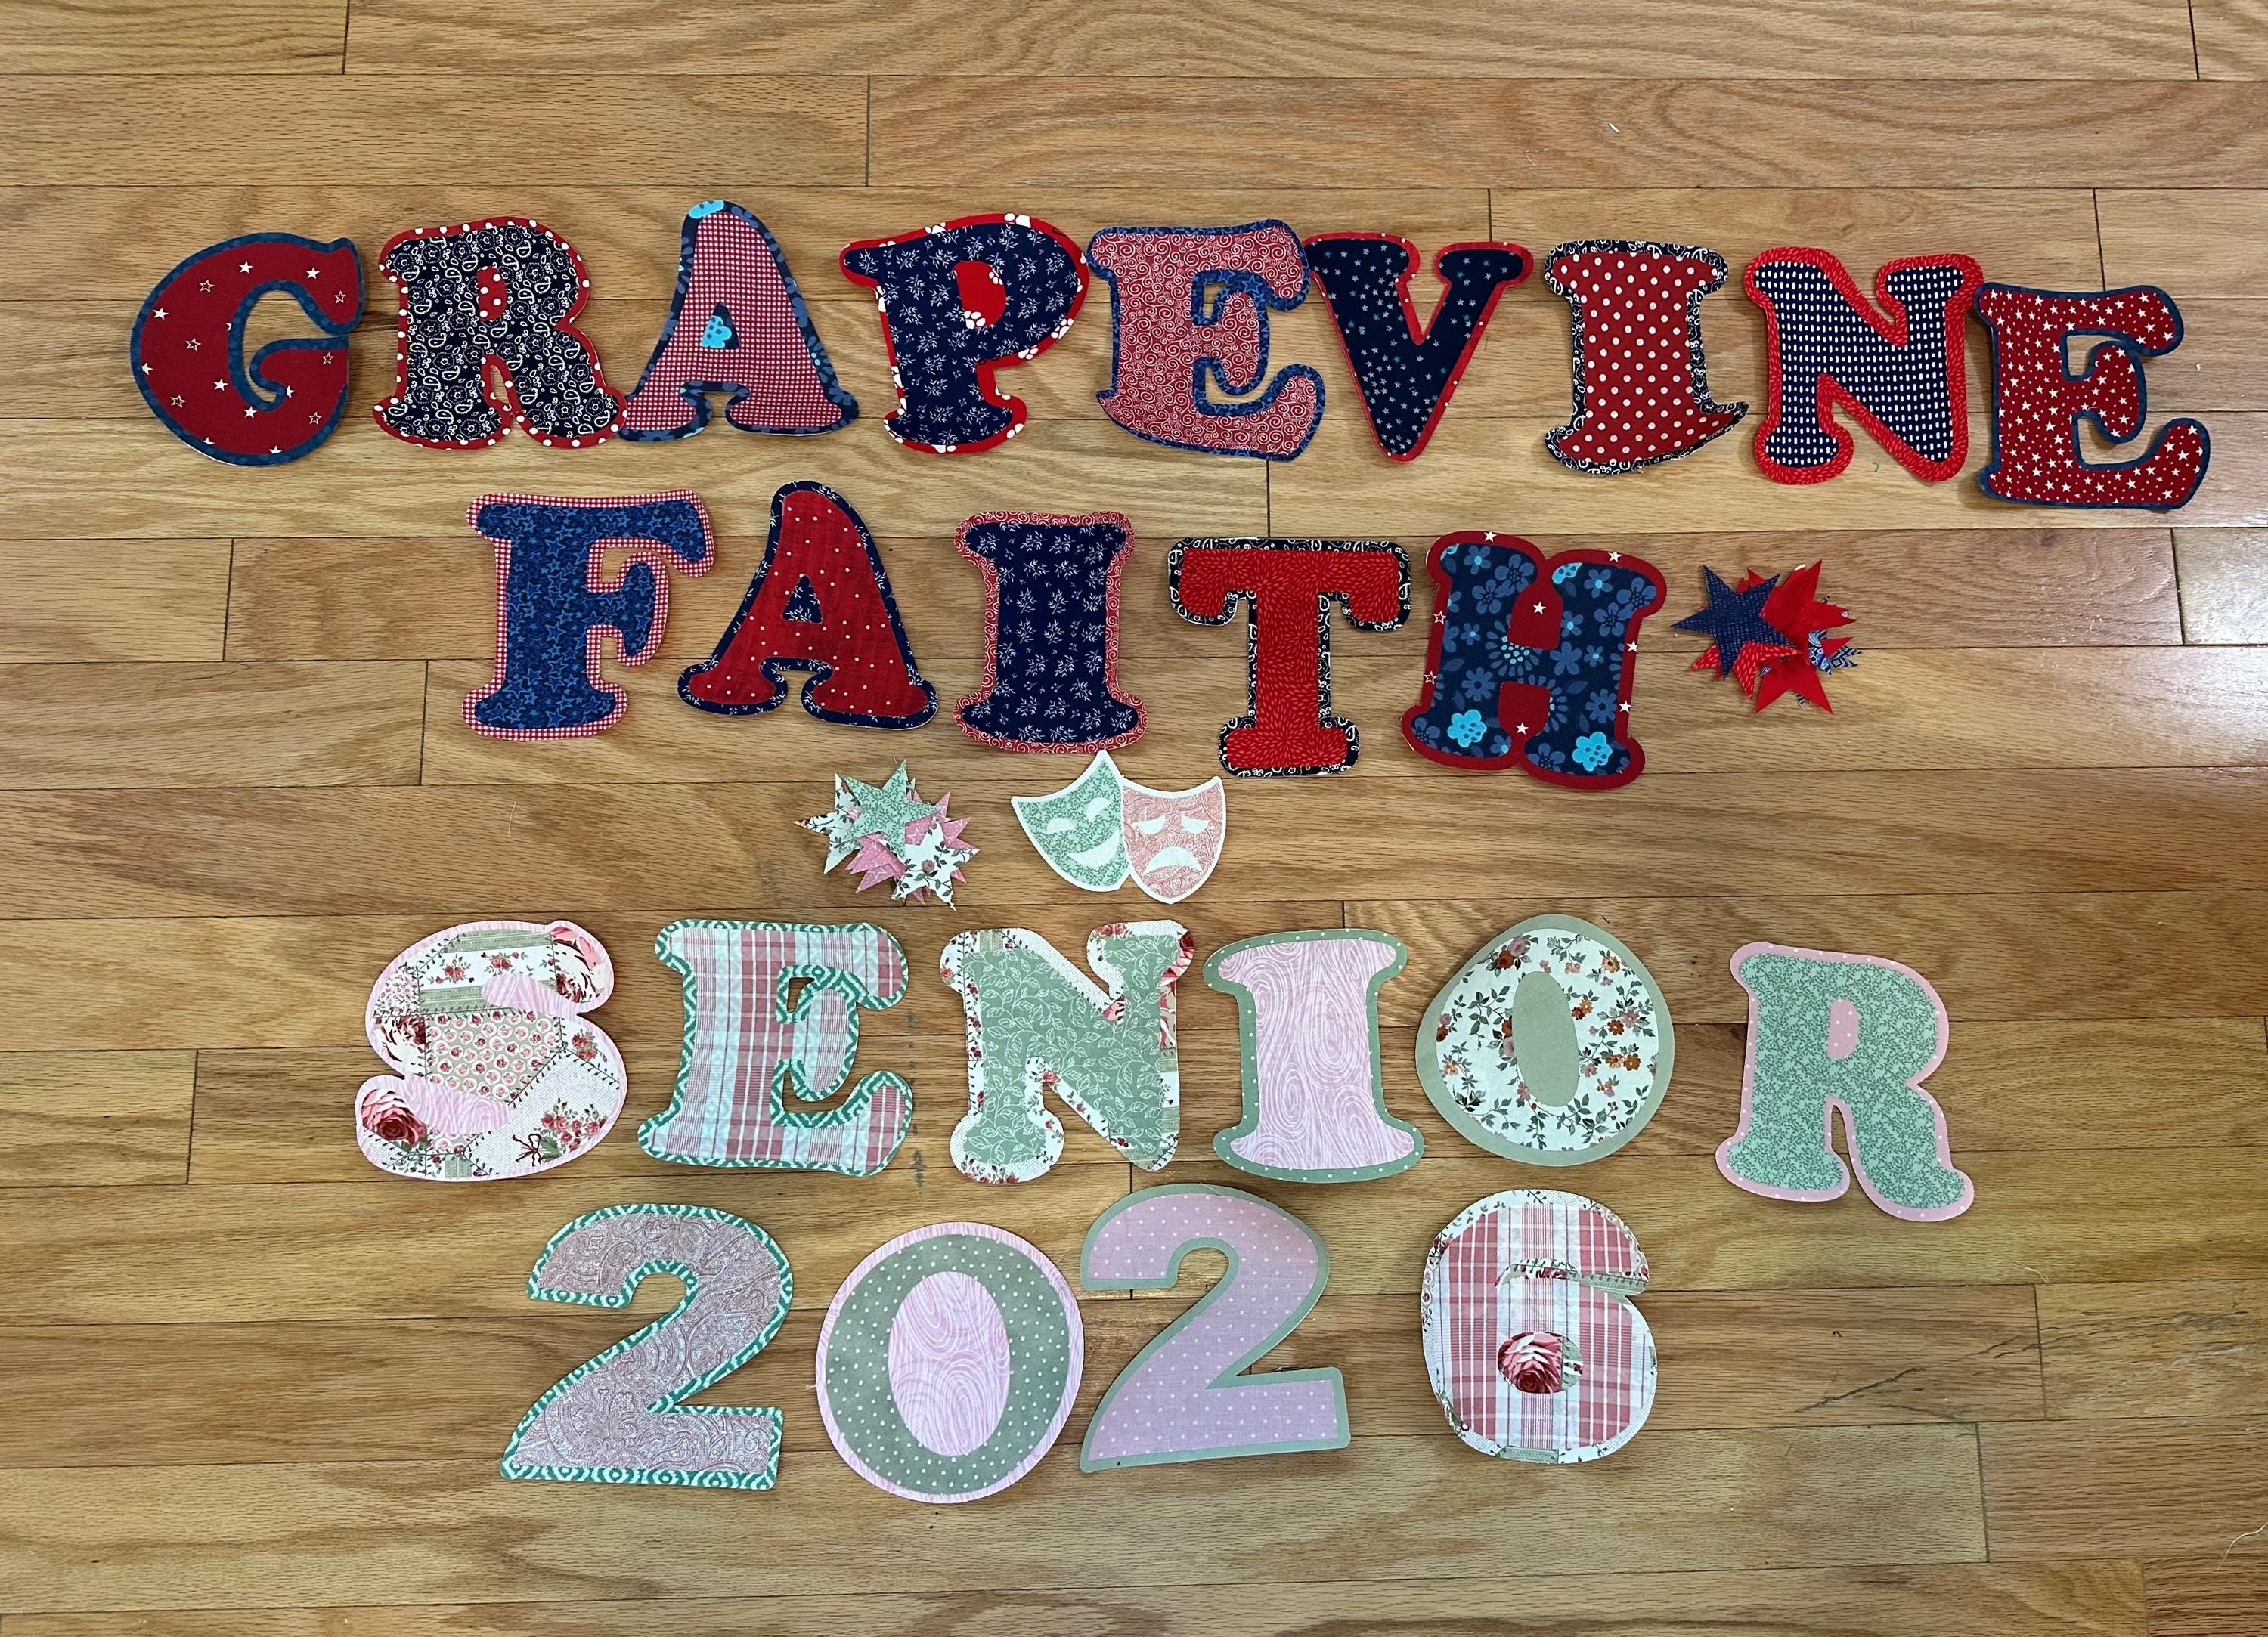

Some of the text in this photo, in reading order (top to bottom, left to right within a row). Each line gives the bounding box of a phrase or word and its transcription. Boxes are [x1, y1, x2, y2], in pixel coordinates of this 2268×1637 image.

[131, 200, 2211, 510] GRAPEVINE
[461, 481, 1667, 790] FAITH
[355, 914, 1975, 1222] SENIOR
[500, 1183, 1658, 1504] 2026
